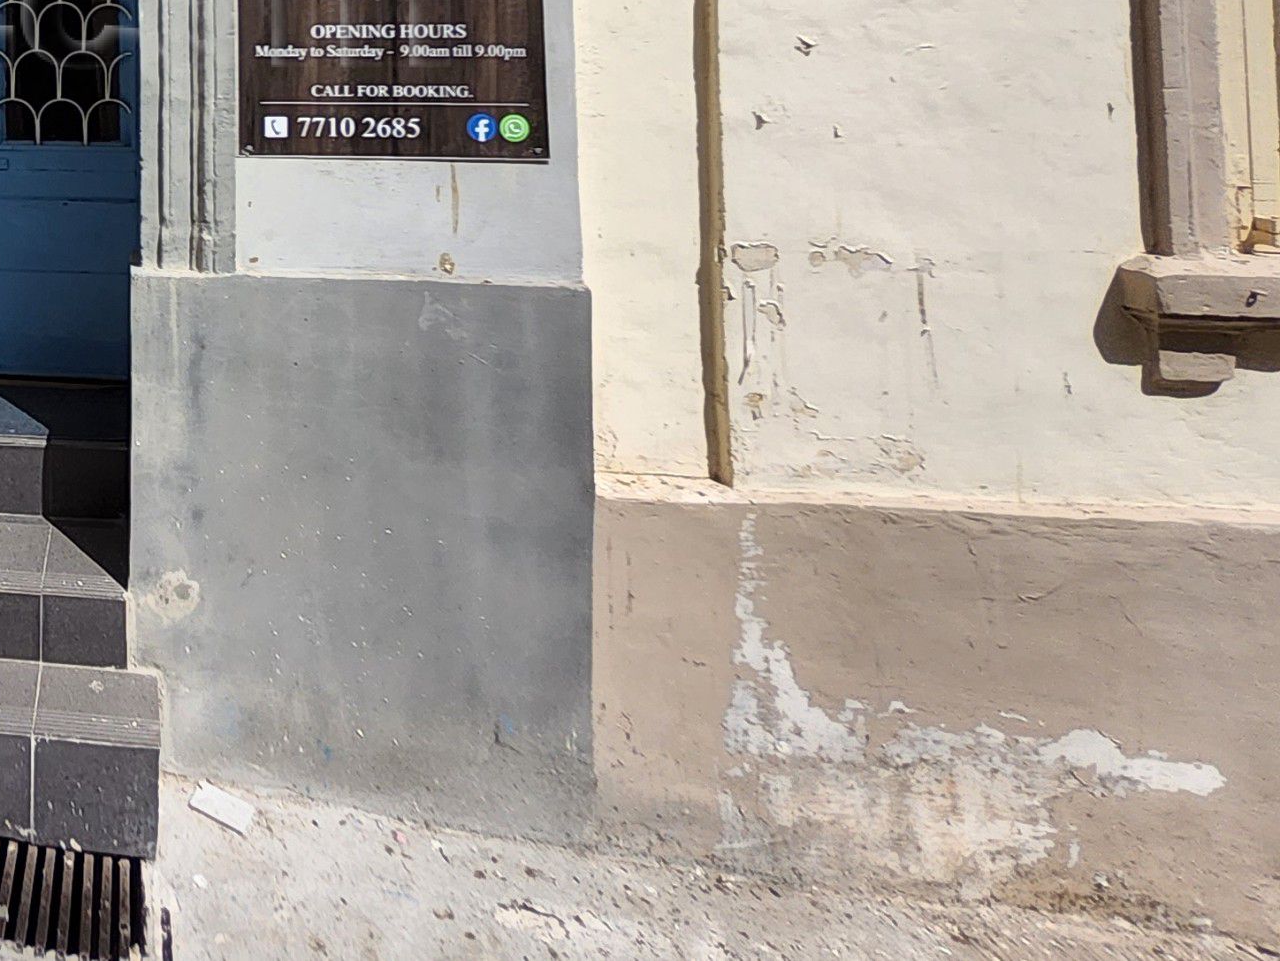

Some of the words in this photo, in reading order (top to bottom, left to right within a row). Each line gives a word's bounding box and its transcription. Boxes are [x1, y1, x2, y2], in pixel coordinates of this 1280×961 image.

[310, 24, 396, 39] OPENING
[400, 23, 467, 39] HOURS
[255, 45, 308, 60] Monday
[310, 46, 324, 57] to
[326, 45, 384, 60] Saturday
[399, 45, 450, 58] 9.00am
[452, 44, 472, 57] till
[474, 44, 527, 60] 9.00pm
[310, 85, 354, 98] CALL
[356, 85, 389, 98] FOR
[392, 85, 474, 98] BOOKING.
[296, 117, 356, 138] 7710
[361, 117, 421, 138] 2685
